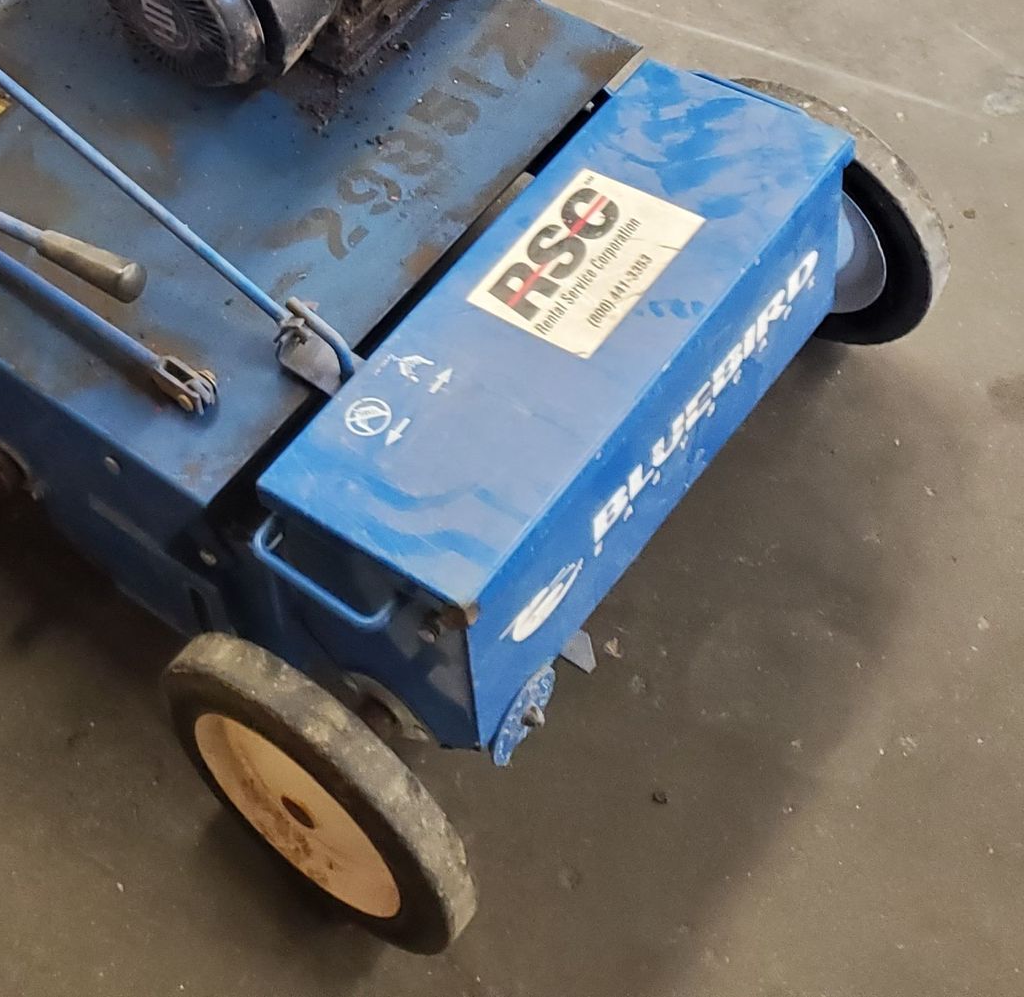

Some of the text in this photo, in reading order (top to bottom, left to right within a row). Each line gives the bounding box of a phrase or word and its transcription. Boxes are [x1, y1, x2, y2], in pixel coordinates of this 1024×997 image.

[488, 188, 620, 322] RSC
[534, 217, 642, 335] Rental Service Corporation
[592, 250, 818, 546] BLUEBIRD
